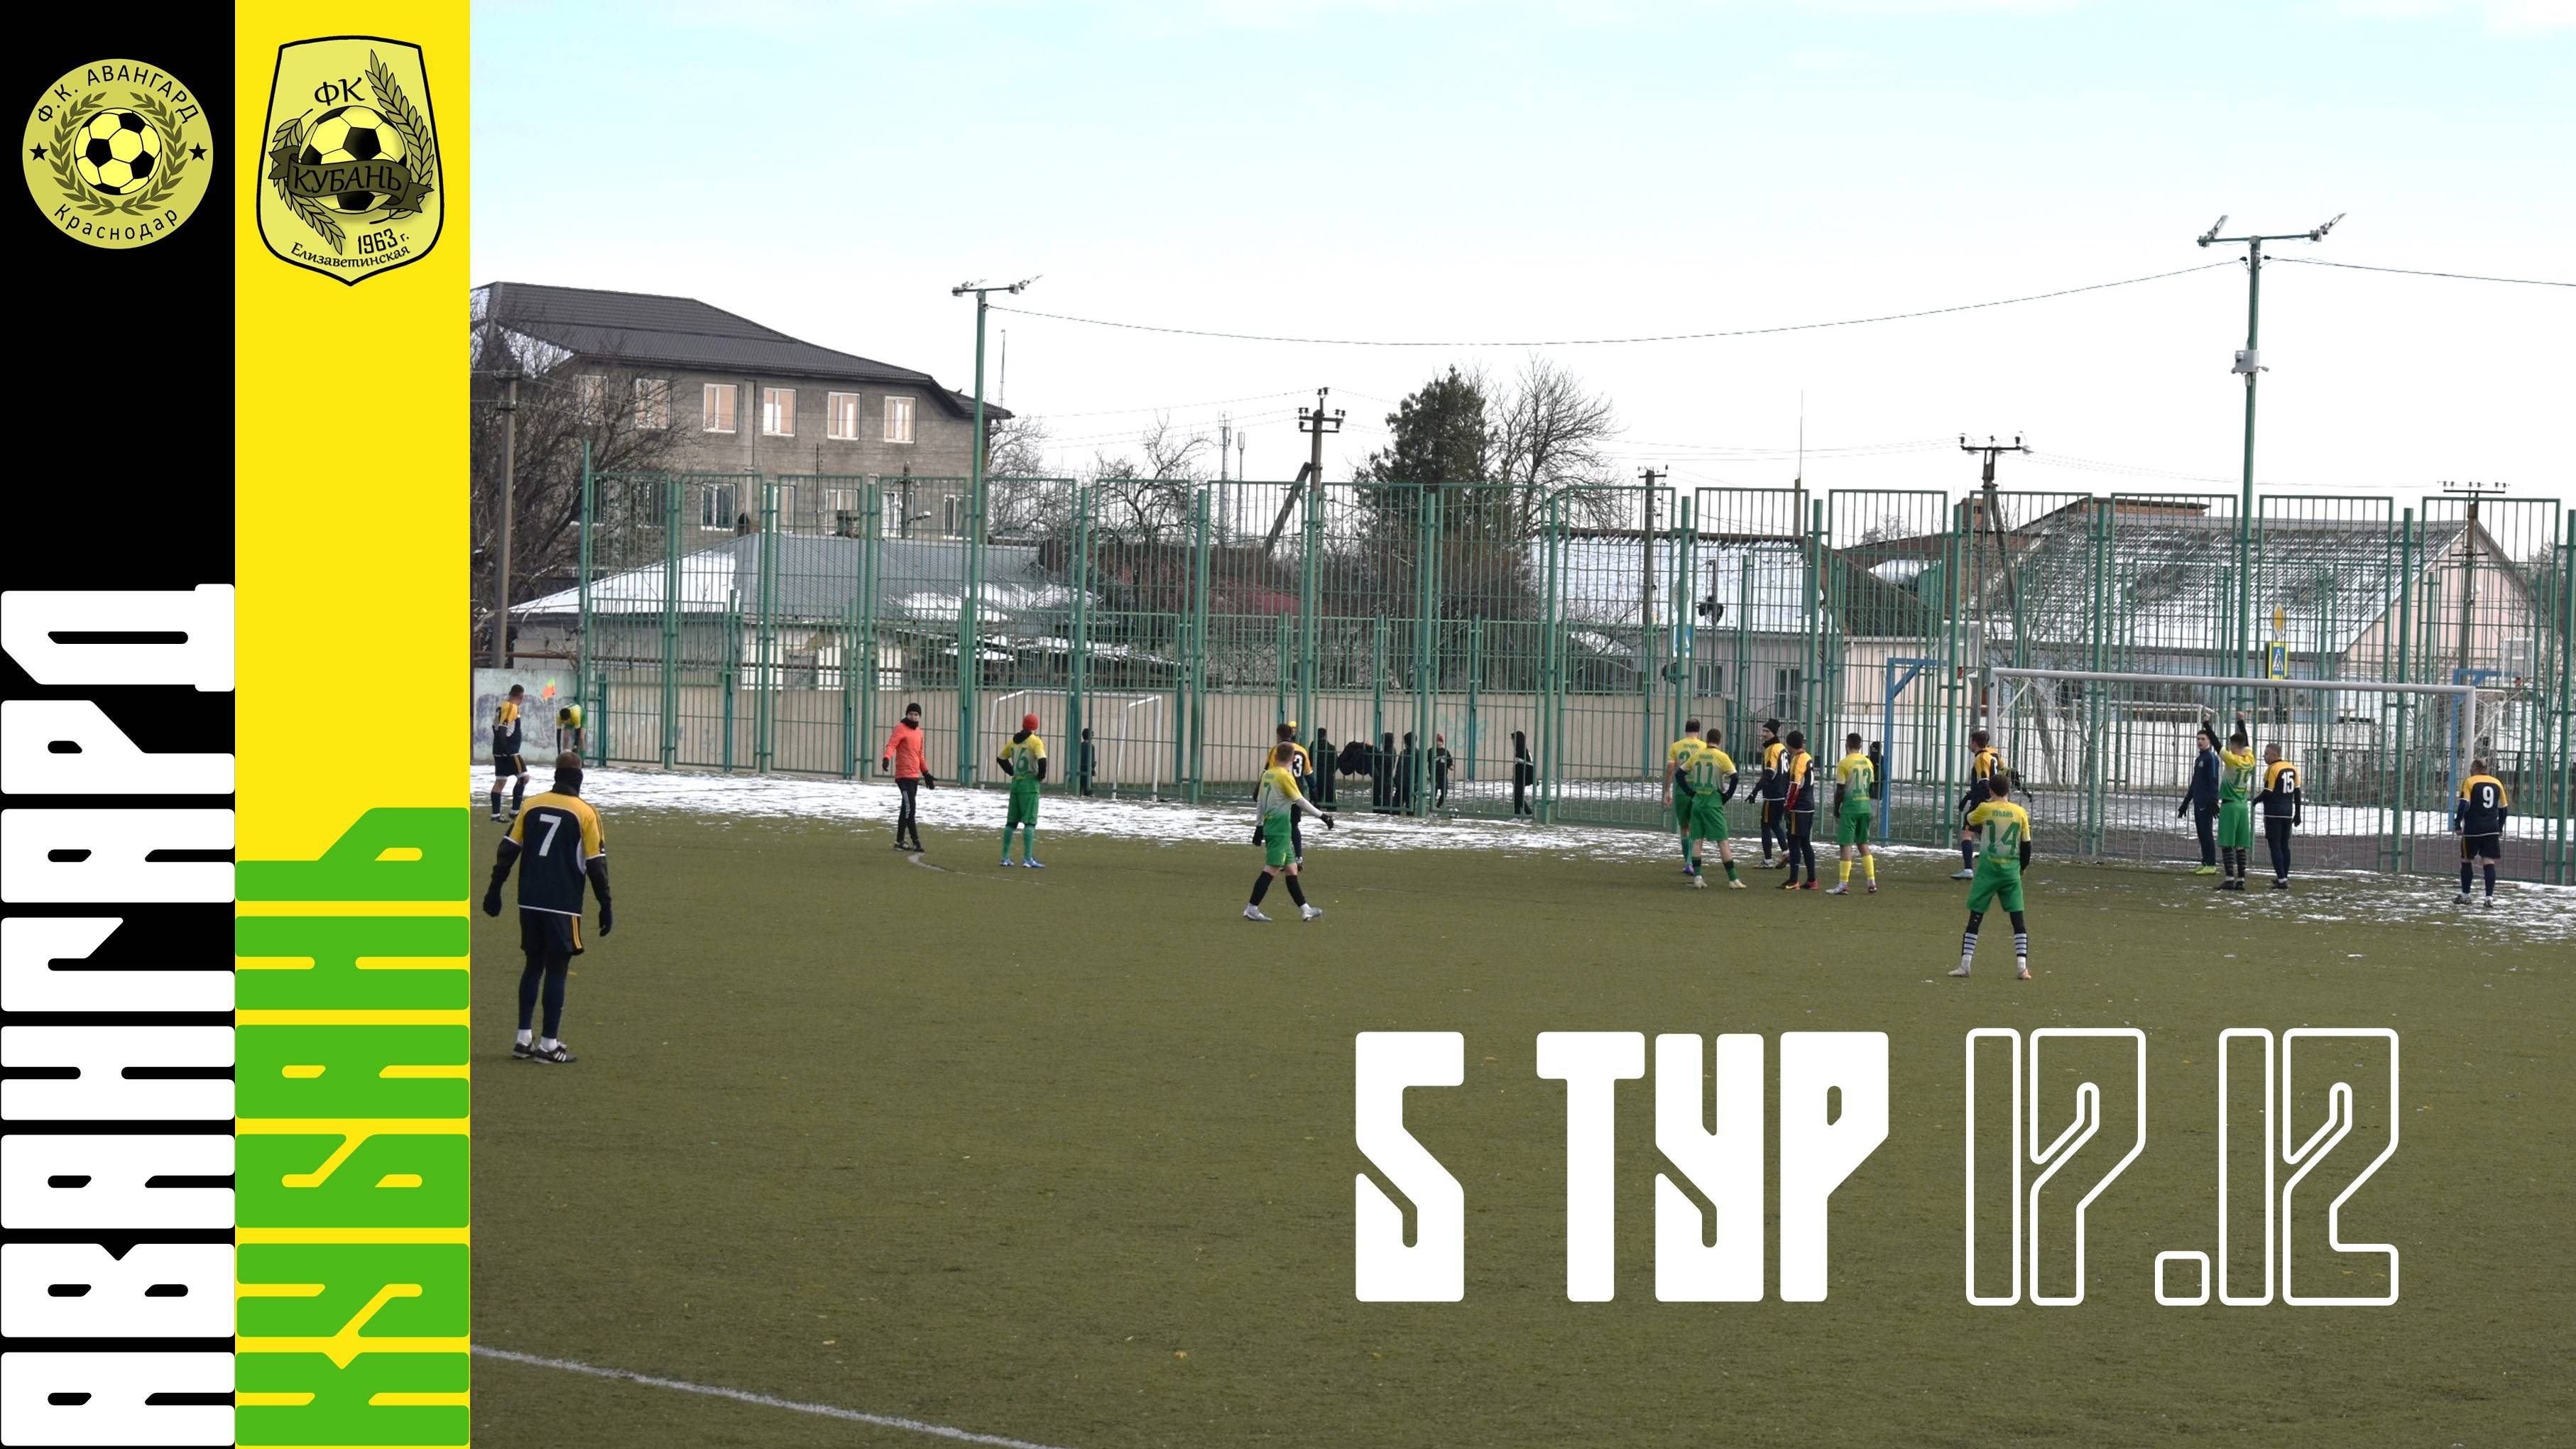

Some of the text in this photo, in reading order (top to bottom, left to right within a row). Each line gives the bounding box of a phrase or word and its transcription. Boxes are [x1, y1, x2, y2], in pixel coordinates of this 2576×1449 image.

[1695, 760, 1713, 787] 11
[2281, 771, 2295, 794] 15
[2482, 786, 2494, 809] 9
[539, 814, 562, 857] 7
[1986, 819, 2021, 856] 14
